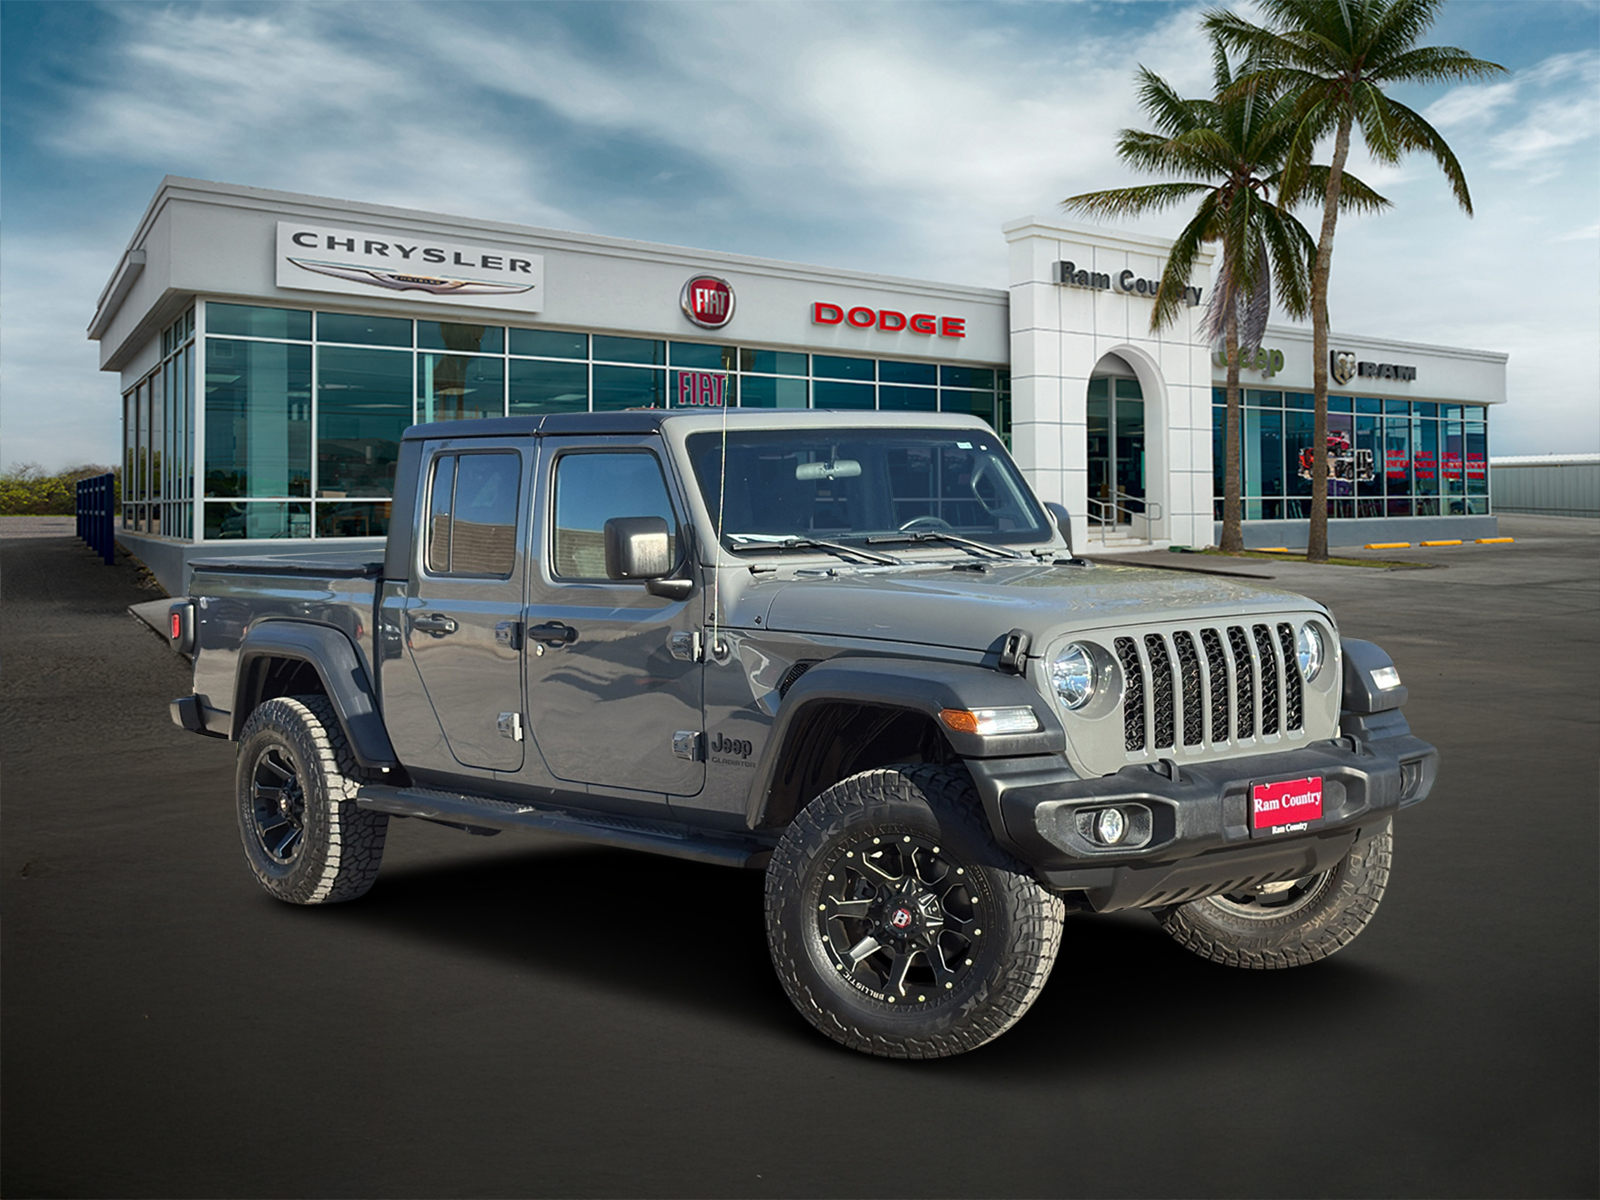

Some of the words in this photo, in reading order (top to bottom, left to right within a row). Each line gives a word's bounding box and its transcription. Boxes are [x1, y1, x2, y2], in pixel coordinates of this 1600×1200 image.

[292, 232, 533, 274] CHRYSLER
[1052, 260, 1111, 291] Ram
[1112, 269, 1203, 307] Coury
[695, 287, 728, 316] FIAT
[812, 301, 967, 339] DODGE
[1358, 361, 1417, 382] RAM
[678, 371, 727, 406] FIAT
[712, 732, 753, 759] Jeep
[712, 756, 756, 769] GLADIATOR
[1254, 798, 1280, 813] Ram
[1281, 790, 1322, 808] Country
[1271, 825, 1285, 835] Ram
[1285, 822, 1308, 833] Country
[842, 971, 886, 1001] BALLISTIC
